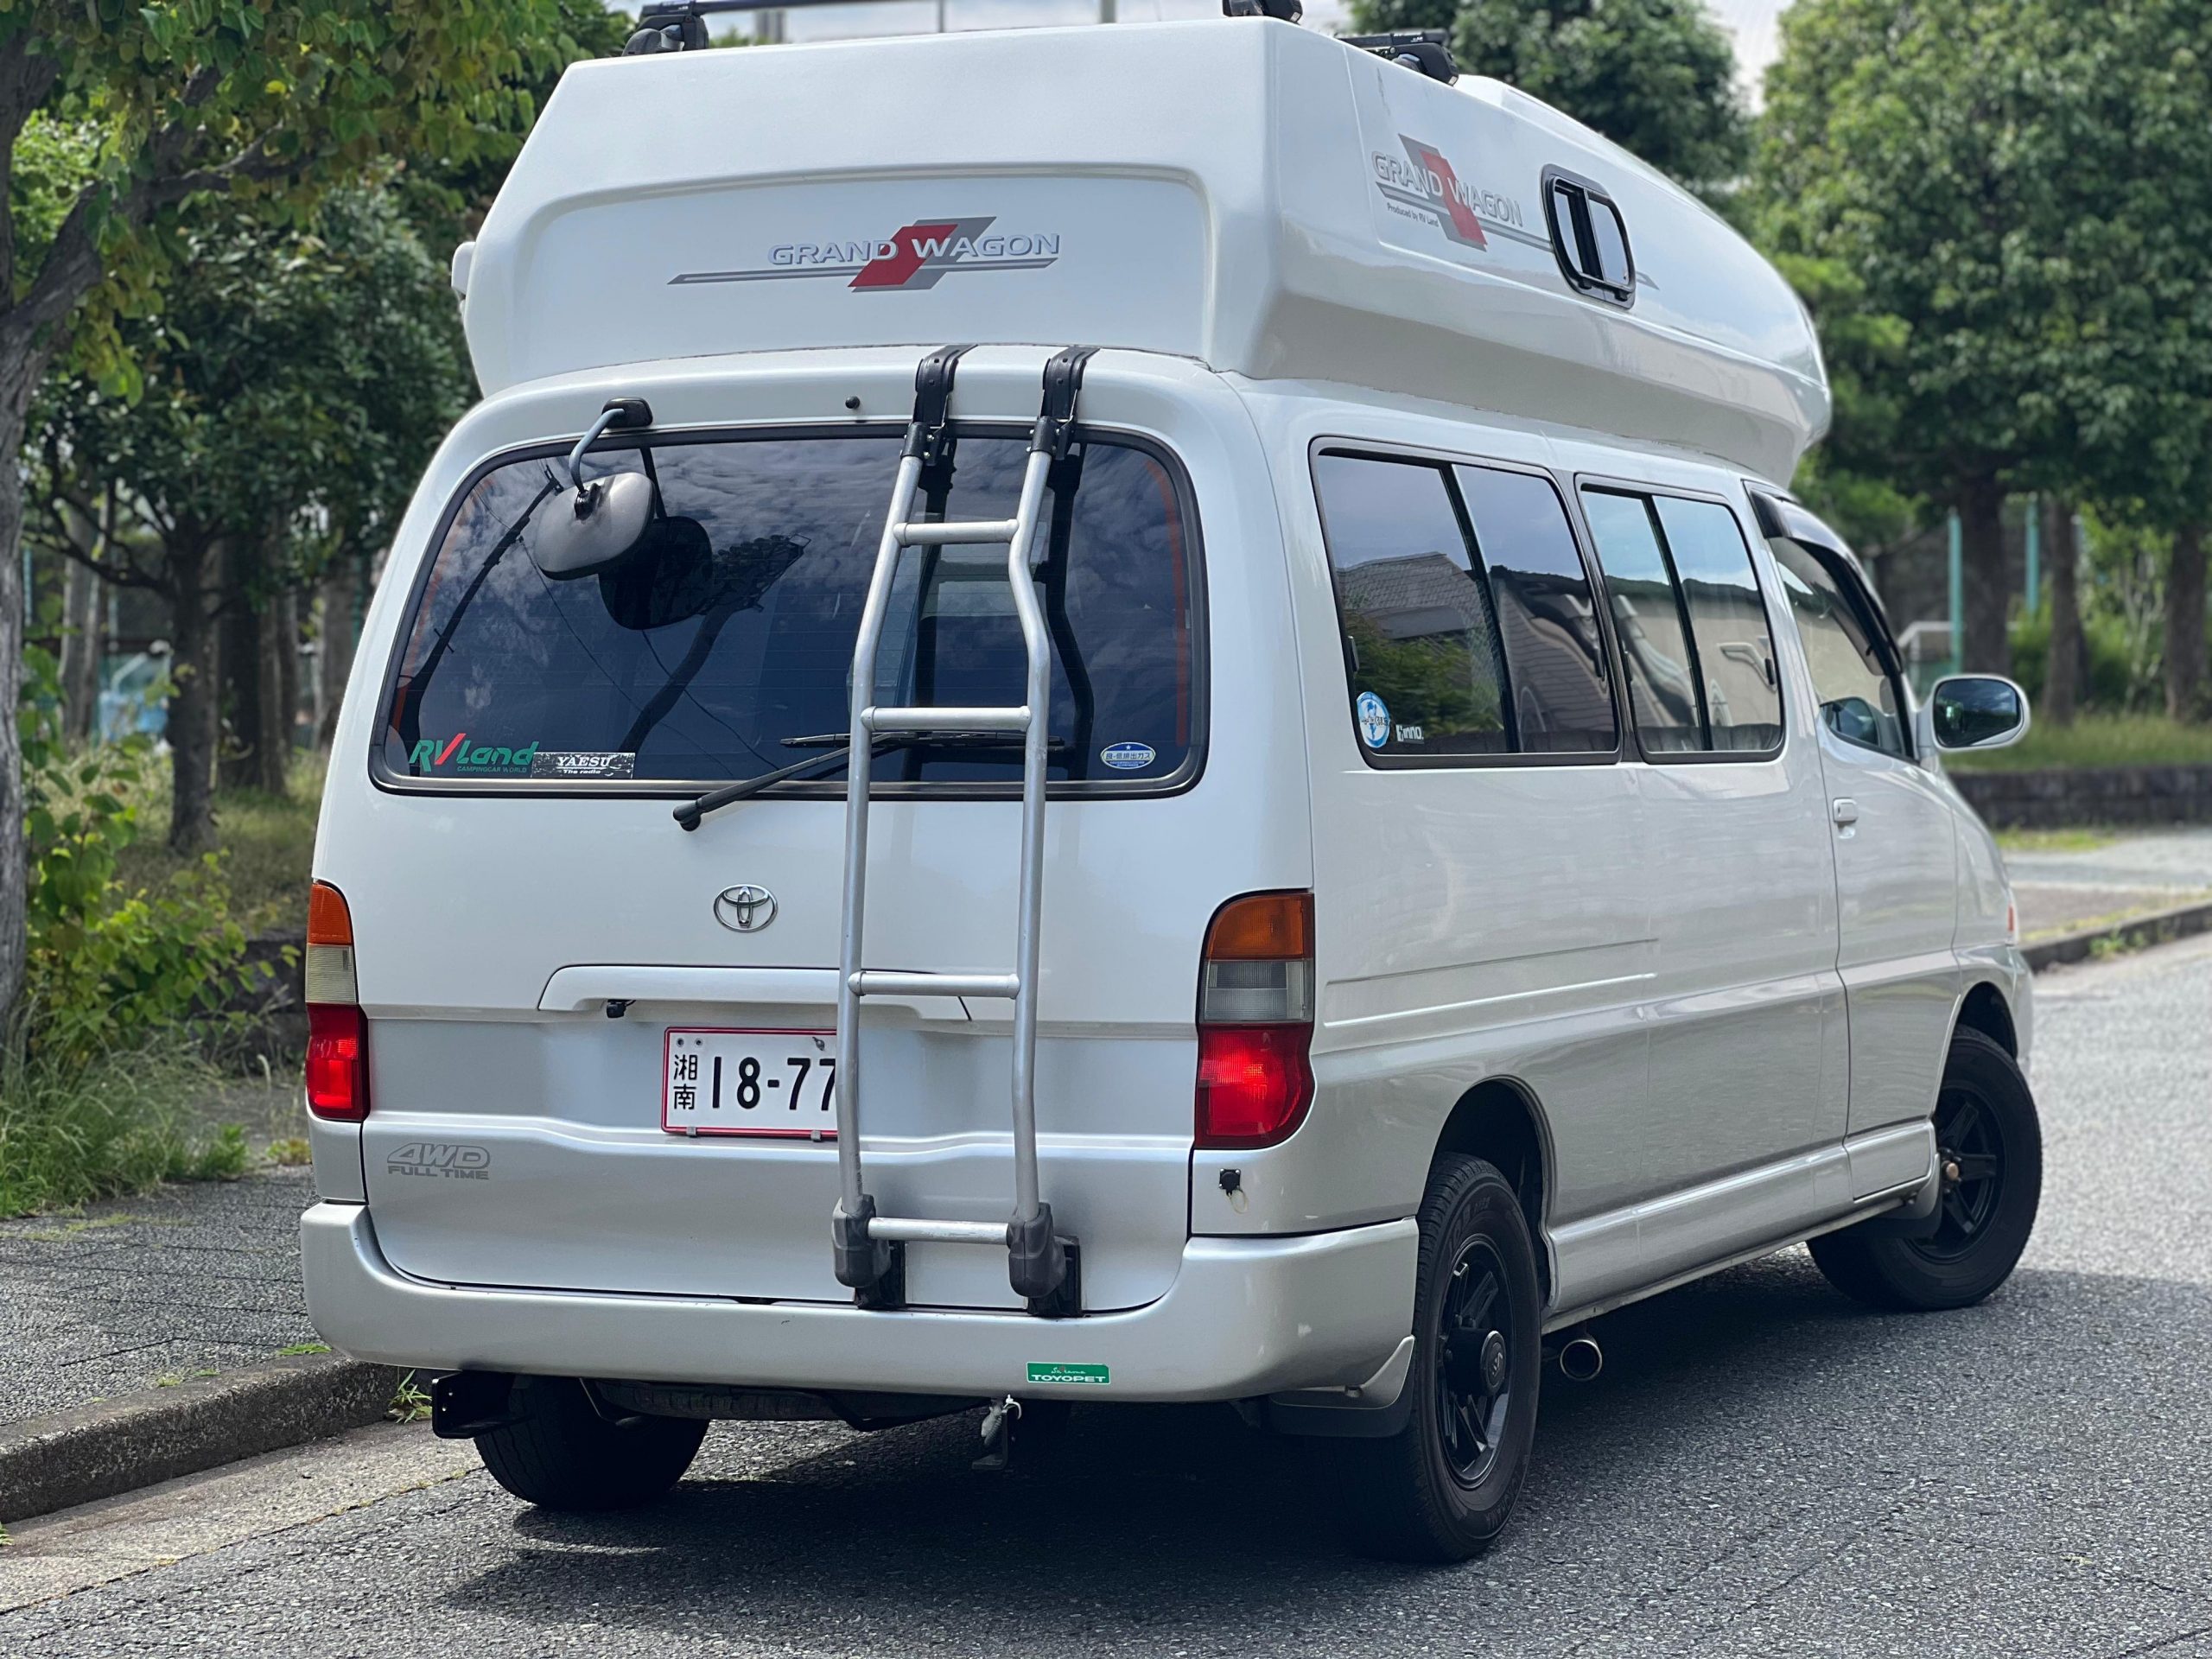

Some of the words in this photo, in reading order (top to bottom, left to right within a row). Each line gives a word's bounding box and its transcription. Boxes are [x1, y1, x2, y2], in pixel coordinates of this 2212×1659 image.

[1372, 151, 1443, 197] GRAND
[1447, 177, 1523, 227] WAGON
[767, 239, 899, 265] GRAND
[912, 232, 1060, 257] WAGON
[557, 756, 612, 767] YAESU
[673, 1054, 698, 1110] 湘南
[712, 1056, 836, 1111] 18-77
[387, 1142, 491, 1169] 4WD
[387, 1166, 438, 1177] FULL
[440, 1168, 490, 1180] TIME
[1031, 1374, 1106, 1382] TOYOPET
